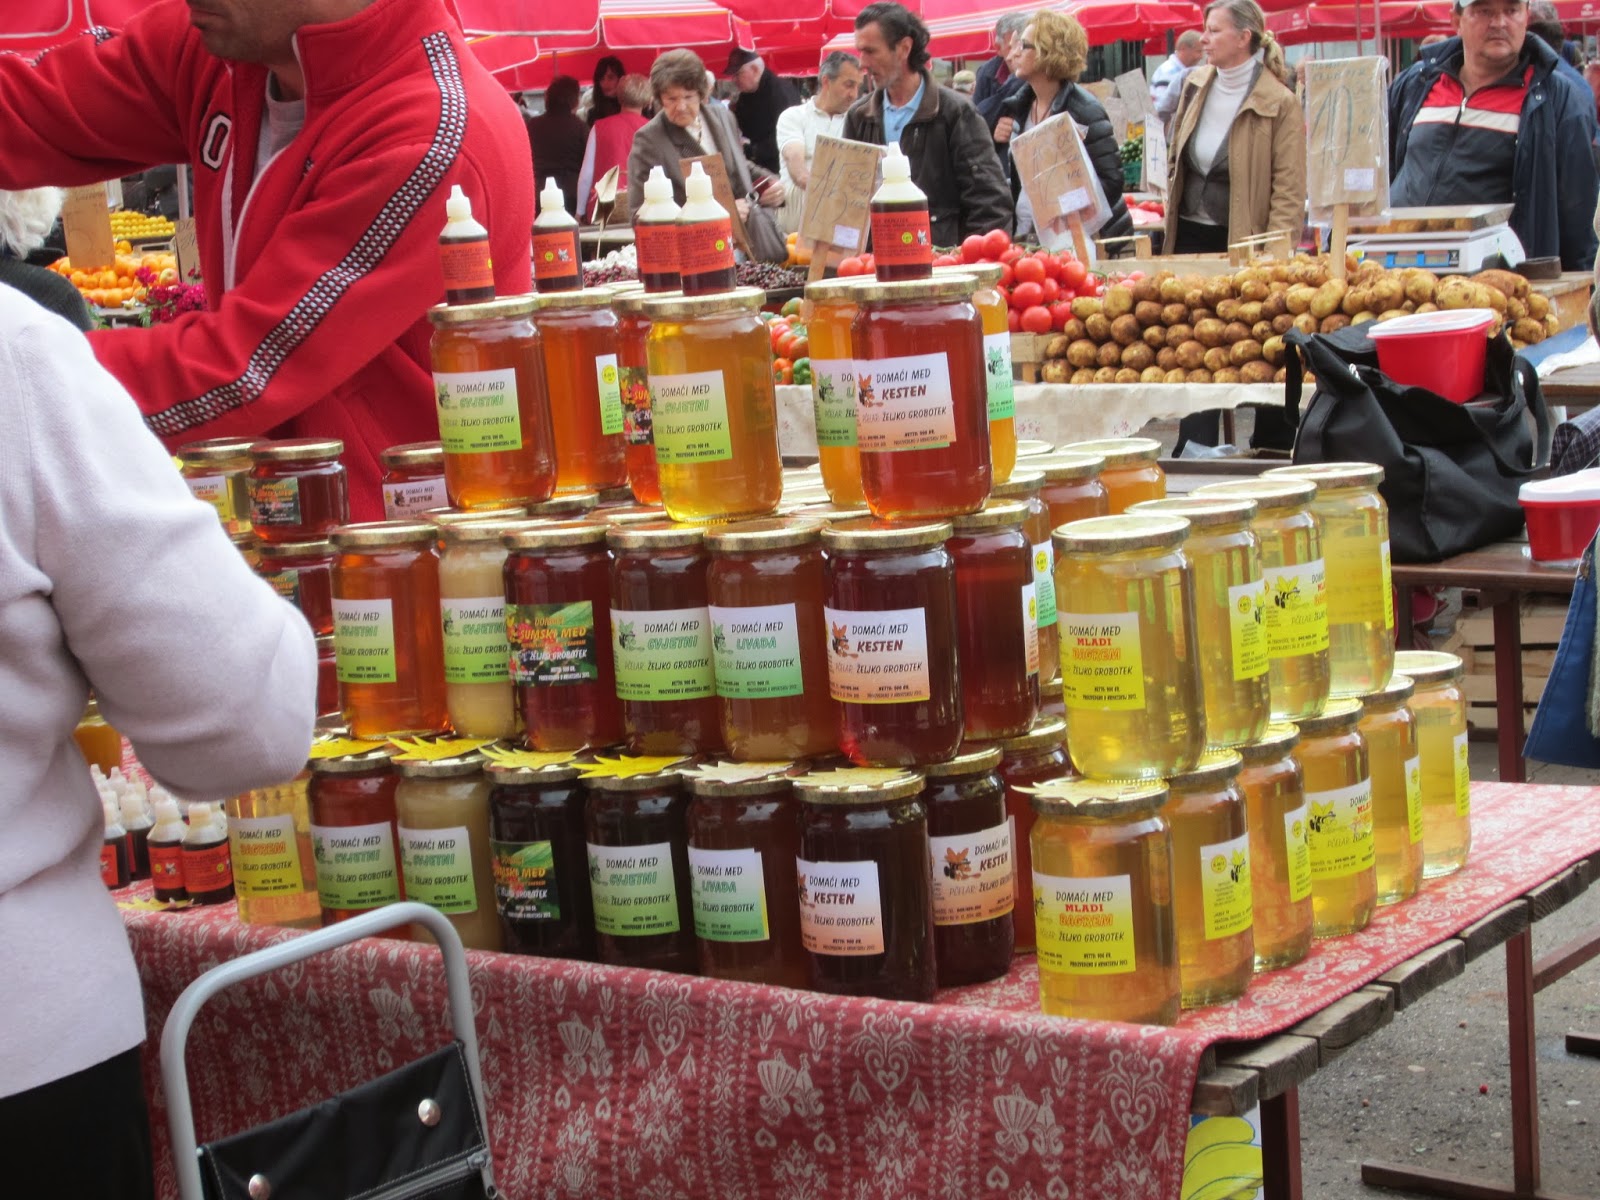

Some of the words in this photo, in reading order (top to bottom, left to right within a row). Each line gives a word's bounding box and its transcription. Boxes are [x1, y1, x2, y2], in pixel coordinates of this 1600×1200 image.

[876, 369, 908, 383] DOMAĆI
[911, 368, 931, 381] MED
[456, 381, 485, 394] DOMAĆI
[488, 381, 505, 392] MED
[661, 385, 688, 397] DOMAĆI
[691, 384, 710, 396] MED
[882, 385, 927, 400] KESTEN
[483, 415, 515, 426] GROBOTEK
[882, 409, 906, 422] ŽELJKO
[908, 407, 947, 419] GROBOTEK
[687, 422, 722, 433] GROBOTEK
[362, 612, 380, 621] MED
[460, 607, 488, 619] DOMAĆI
[491, 608, 505, 618] ME
[561, 625, 587, 638] MED
[644, 621, 678, 633] DOMAĆI
[681, 620, 700, 631] MED
[731, 622, 762, 633] DOMAĆI
[765, 621, 784, 632] MED
[852, 623, 885, 635] DOMAĆI
[888, 623, 909, 634] MED
[1069, 625, 1098, 636] DOMAĆI
[1101, 625, 1121, 636] MED
[736, 637, 777, 650] LIVADA
[857, 640, 904, 653] KESTEN
[1077, 638, 1112, 646] MLADI
[357, 648, 390, 656] GROBOTEK
[485, 644, 508, 654] GROBO
[552, 648, 588, 660] GROBOTEK
[647, 660, 671, 671] ŽELJKO
[673, 658, 710, 669] GROBOTEK
[735, 659, 757, 670] ŽELJKO
[759, 658, 795, 669] GROBOTEK
[856, 662, 881, 674] ŽELJKO
[883, 662, 922, 673] GROBOTEK
[1073, 665, 1092, 676] ŽELJKO
[1094, 666, 1133, 676] GROBOTEK
[239, 829, 263, 840] DOMAĆI
[265, 828, 282, 839] MED
[330, 836, 360, 848] DOMAĆI
[363, 835, 381, 847] MED
[409, 839, 434, 850] DOMAĆI
[437, 839, 456, 849] MED
[974, 838, 1000, 856] DOMAĆI
[260, 861, 292, 871] GROBOTEK
[606, 857, 636, 869] DOMAĆI
[638, 857, 658, 868] MED
[358, 870, 393, 882] GROBOTEK
[521, 867, 546, 878] MED
[697, 864, 722, 876] DOMAĆI
[724, 866, 743, 876] MED
[434, 875, 468, 886] GROBOTEK
[809, 876, 837, 888] DOMAĆI
[840, 877, 860, 888] MED
[634, 894, 671, 905] GROBOTEK
[813, 891, 855, 905] KESTEN
[1056, 890, 1089, 902] DOMAĆI
[1092, 891, 1114, 902] MED
[720, 903, 755, 913] GROBOTEK
[1065, 904, 1103, 912] MLADI
[836, 916, 876, 926] GROBOTEK
[1058, 931, 1082, 942] ŽELJKO
[1084, 931, 1124, 943] GROBOTEK
